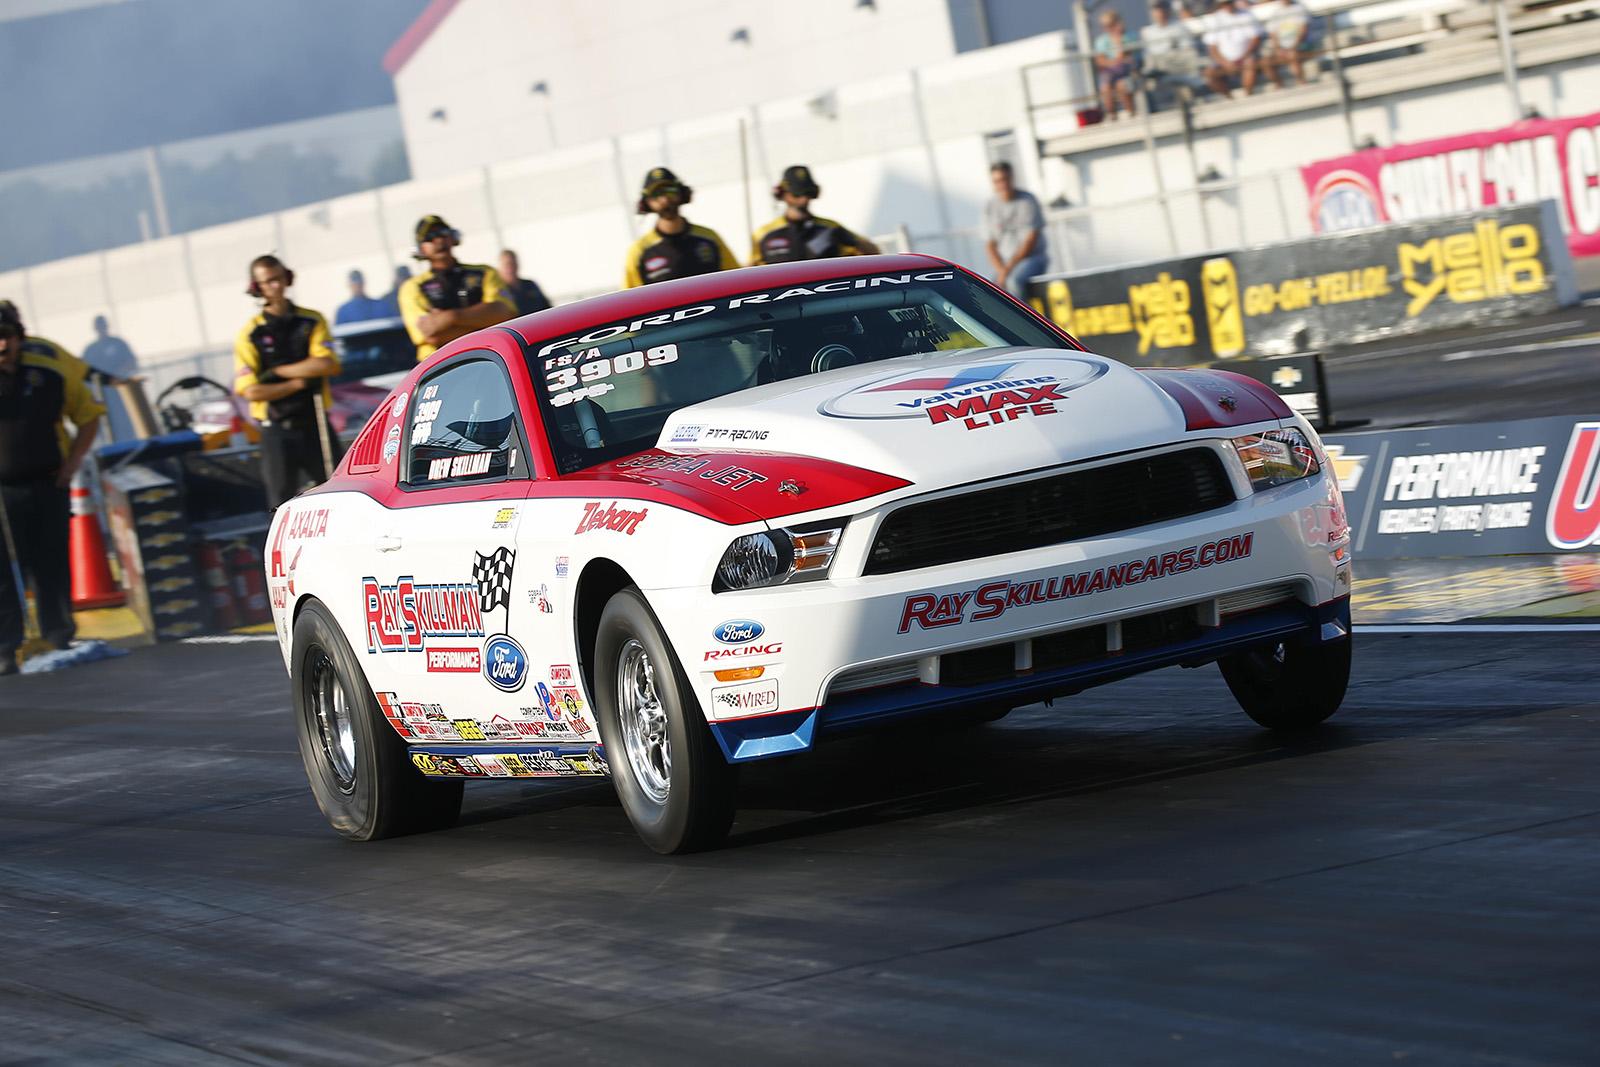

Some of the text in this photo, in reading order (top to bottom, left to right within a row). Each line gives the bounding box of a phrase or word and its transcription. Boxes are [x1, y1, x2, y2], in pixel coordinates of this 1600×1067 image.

[538, 271, 954, 358] FORD RACING
[545, 347, 601, 371] FS/A
[546, 343, 679, 392] 3909
[896, 375, 1057, 409] Valvoline
[926, 383, 1070, 425] MAX
[963, 401, 1059, 431] LIFE
[450, 452, 493, 478] SKILLMAN
[699, 465, 768, 491] JET
[1383, 445, 1547, 502] PERFORMANCE
[287, 508, 330, 540] AXALTA
[722, 622, 753, 641] Ford
[428, 651, 479, 669] PERFORMANCE
[492, 646, 518, 679] Ford
[704, 642, 783, 662] RACING
[514, 722, 540, 736] COMP
[545, 722, 571, 732] PENSKE
